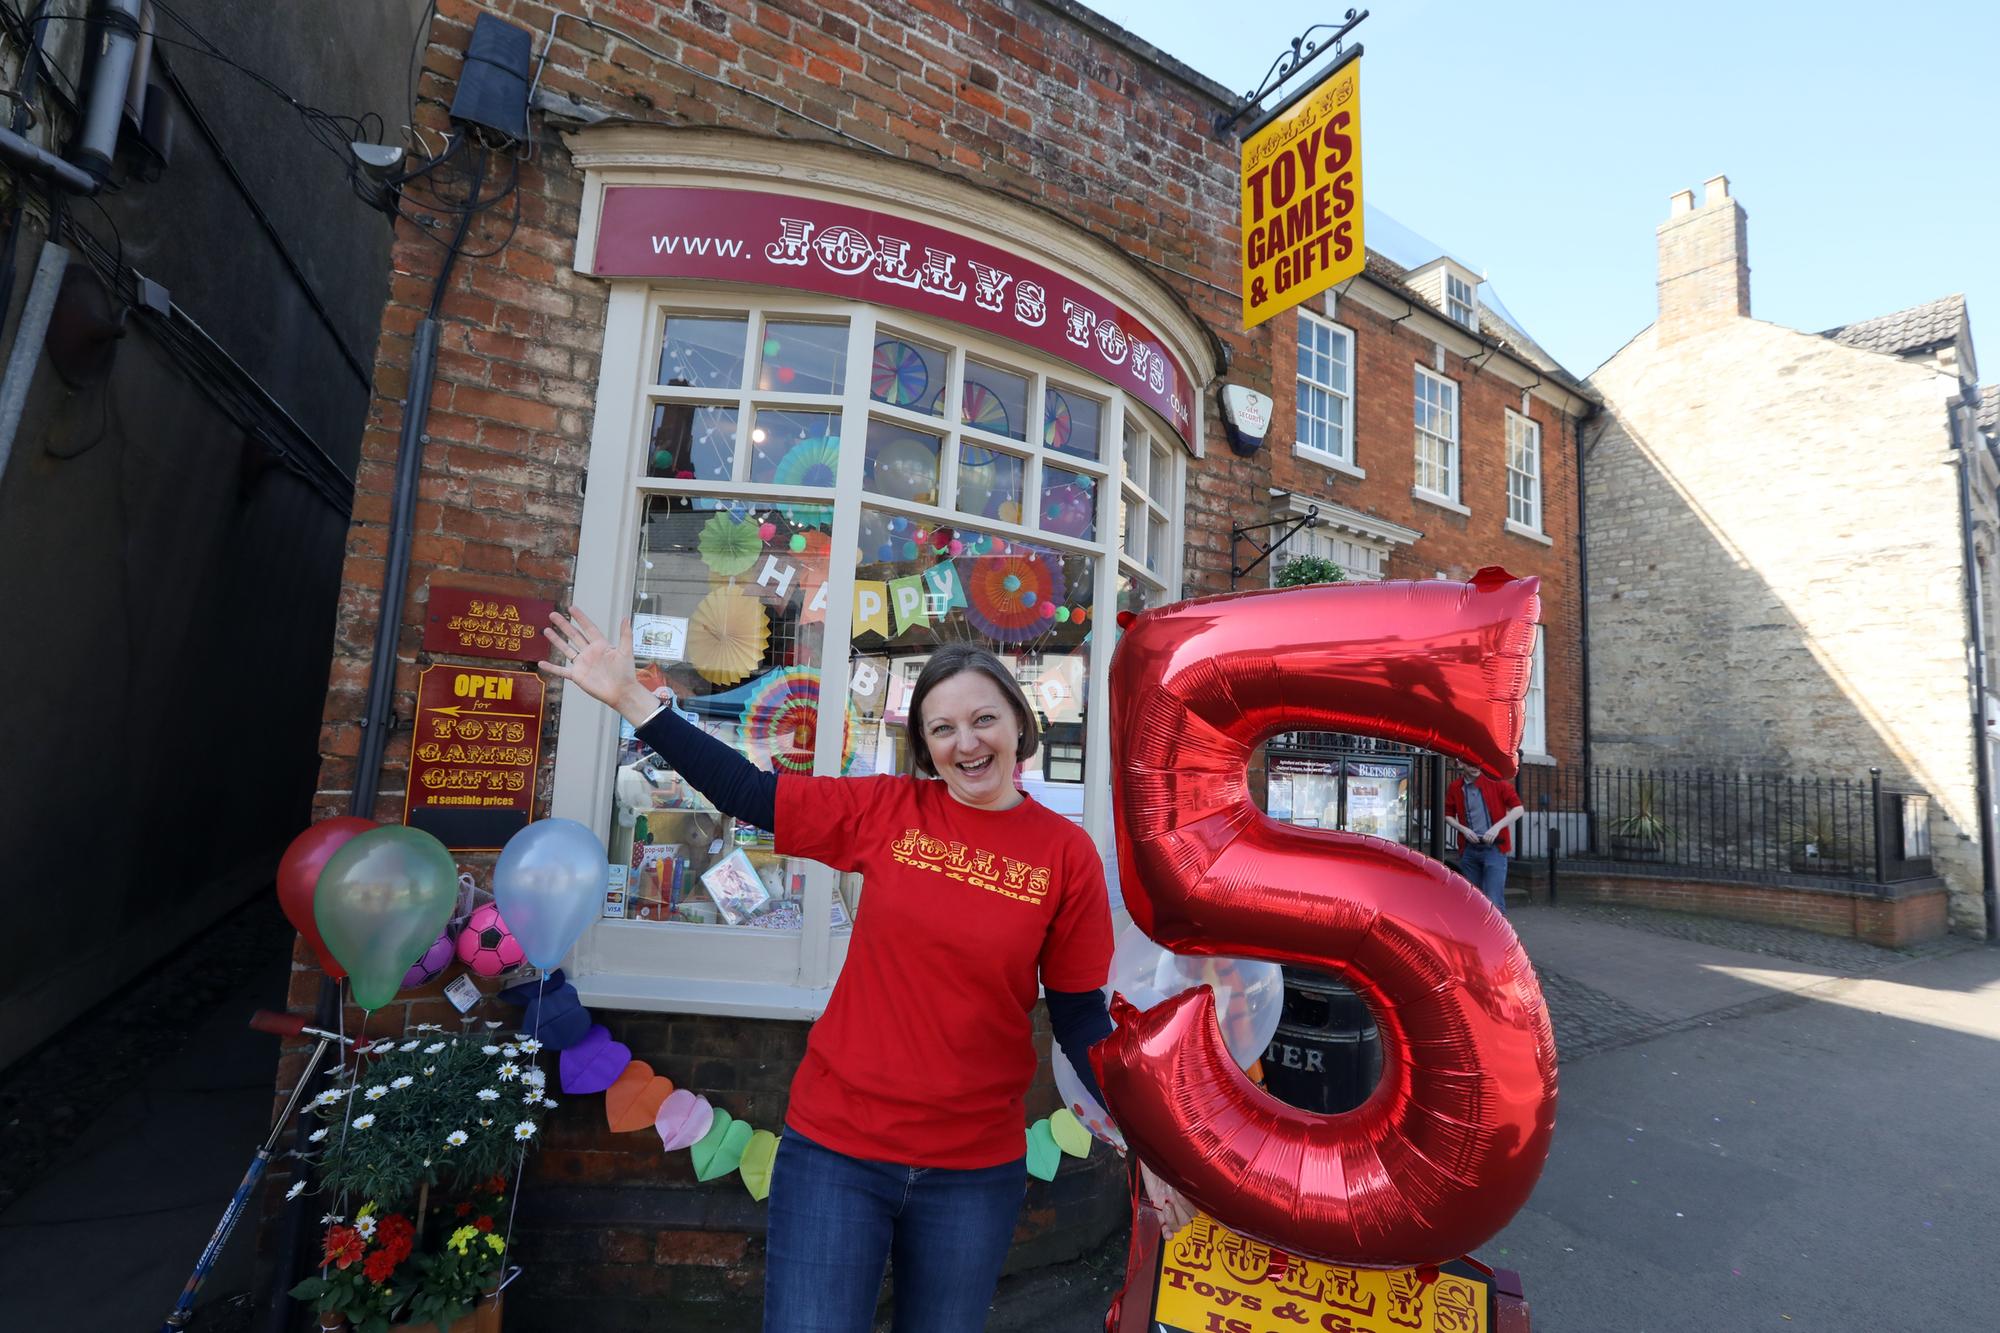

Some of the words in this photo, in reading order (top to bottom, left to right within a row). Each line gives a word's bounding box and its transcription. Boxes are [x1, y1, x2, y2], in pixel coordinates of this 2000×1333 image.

[1247, 110, 1353, 224] TOYS
[1247, 171, 1355, 270] GAMES
[1250, 275, 1268, 308] &
[1274, 220, 1353, 296] GIFTS
[651, 234, 752, 260] www.
[764, 217, 1047, 328] JOLLYS
[1062, 296, 1165, 395] TOYS
[447, 616, 535, 639] JOLLYS
[458, 633, 521, 652] TOYS
[454, 674, 514, 700] OPEN
[472, 699, 492, 711] for
[432, 718, 525, 742] TOYS
[416, 742, 533, 766] GAMES
[420, 767, 525, 791] GIFTS
[1358, 763, 1397, 778] BLETSOES
[427, 795, 437, 805] at
[439, 795, 482, 806] sensible
[483, 796, 514, 807] prices
[890, 829, 1051, 896] JOLLYS
[893, 853, 943, 873] Toys
[945, 872, 965, 882] &
[968, 876, 1041, 905] Games
[1163, 1266, 1262, 1312] Toys
[1271, 1301, 1310, 1324] &
